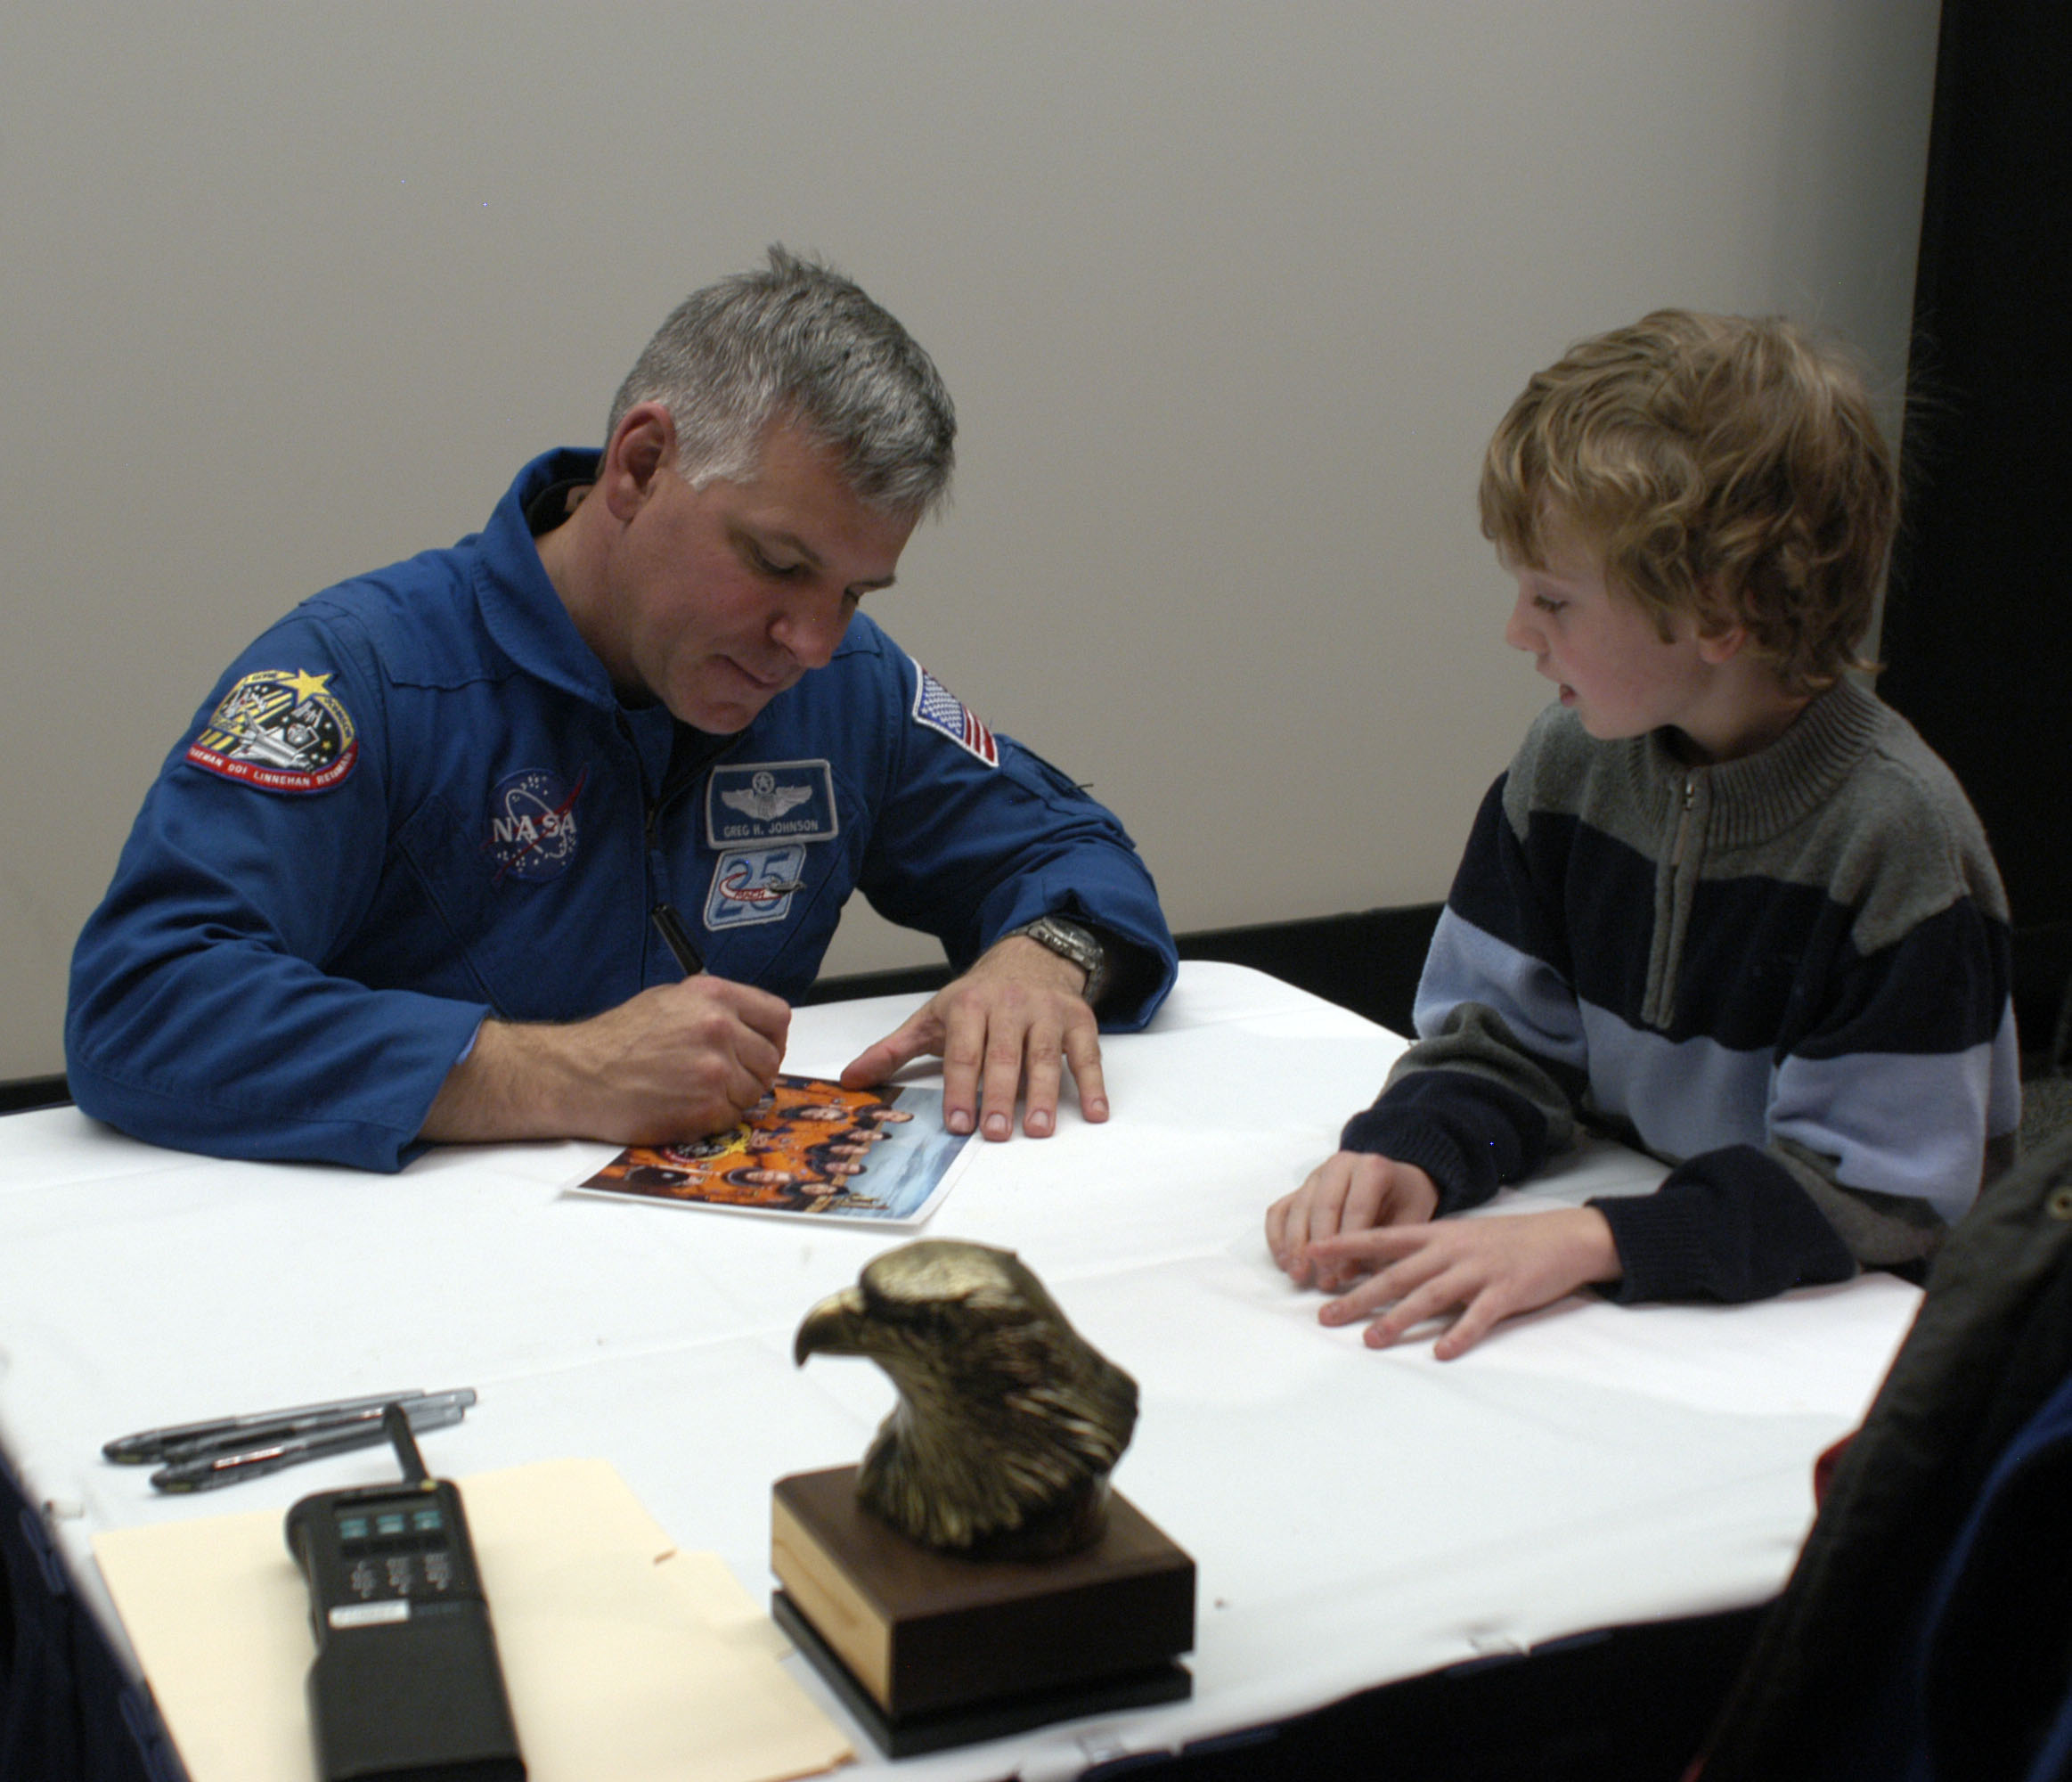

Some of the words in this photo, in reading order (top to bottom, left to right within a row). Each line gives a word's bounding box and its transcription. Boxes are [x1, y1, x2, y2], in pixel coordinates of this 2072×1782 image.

[228, 764, 248, 774] DOI
[254, 771, 310, 786] LINNEHAN
[493, 810, 577, 842] NASA
[723, 825, 749, 838] GREG
[768, 820, 819, 834] JOHNSON
[715, 851, 790, 918] 25
[735, 889, 765, 900] MACH
